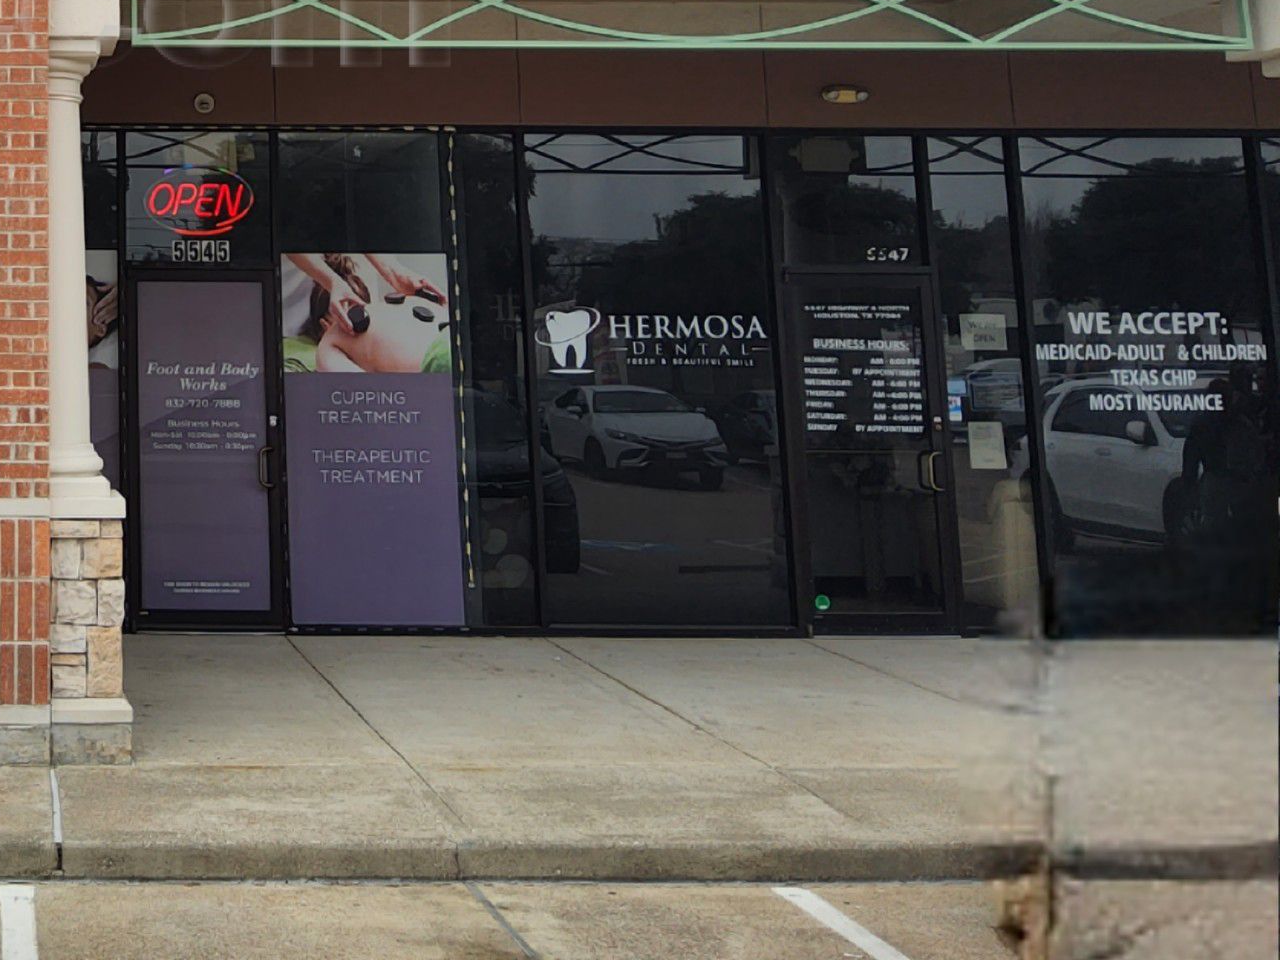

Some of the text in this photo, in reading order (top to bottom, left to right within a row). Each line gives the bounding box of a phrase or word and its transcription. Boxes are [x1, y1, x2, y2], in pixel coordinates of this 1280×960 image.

[148, 182, 245, 218] OPEN
[172, 241, 230, 261] 5545
[866, 247, 909, 261] 5547
[608, 315, 768, 339] HERMOSA
[1068, 312, 1228, 336] WE ACCEPT:
[632, 341, 750, 356] DENTAL
[813, 338, 866, 350] BUSINESS
[1035, 344, 1268, 361] MEDICAID-ADULT & CHILDREN
[147, 361, 259, 379] Foot and Body
[1110, 369, 1198, 386] TEXAS CHIP
[180, 377, 227, 391] Works
[331, 391, 407, 405] CUPPING
[1089, 394, 1225, 412] MOST INSURANCE
[317, 410, 420, 424] TREATMENT
[312, 449, 431, 464] THERAPEUTIC
[320, 469, 424, 484] TREATMENT
